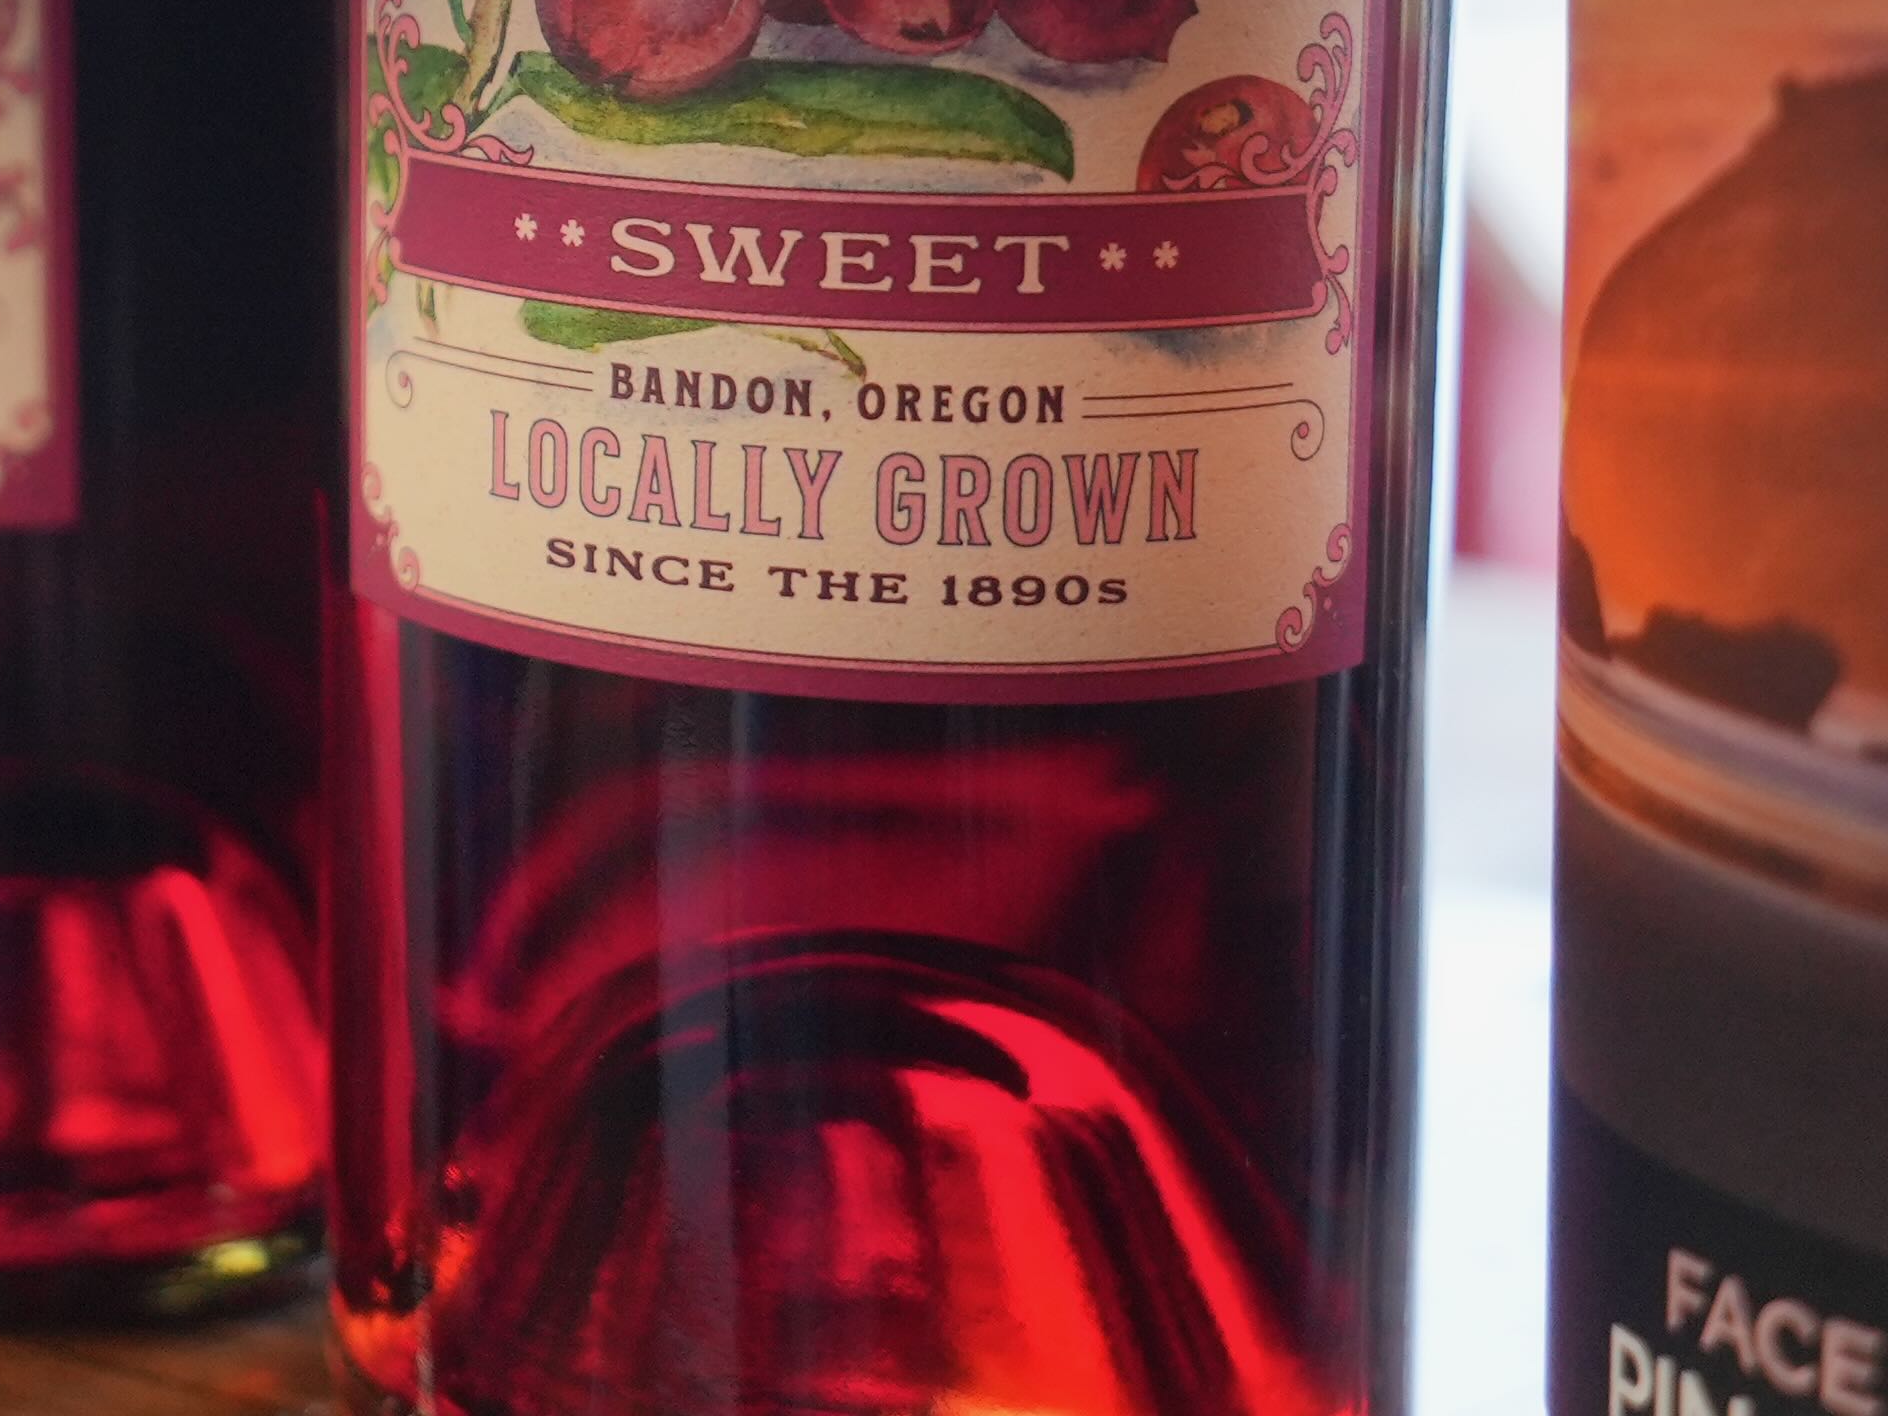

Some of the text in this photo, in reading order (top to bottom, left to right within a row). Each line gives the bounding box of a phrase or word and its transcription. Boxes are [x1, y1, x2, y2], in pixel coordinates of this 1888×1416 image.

[610, 218, 1070, 295] SWEET
[611, 363, 1065, 424] BANDON, OREGON
[490, 410, 1200, 548] LOCALLY GROWN
[546, 539, 1129, 607] SINCE THE 1890s
